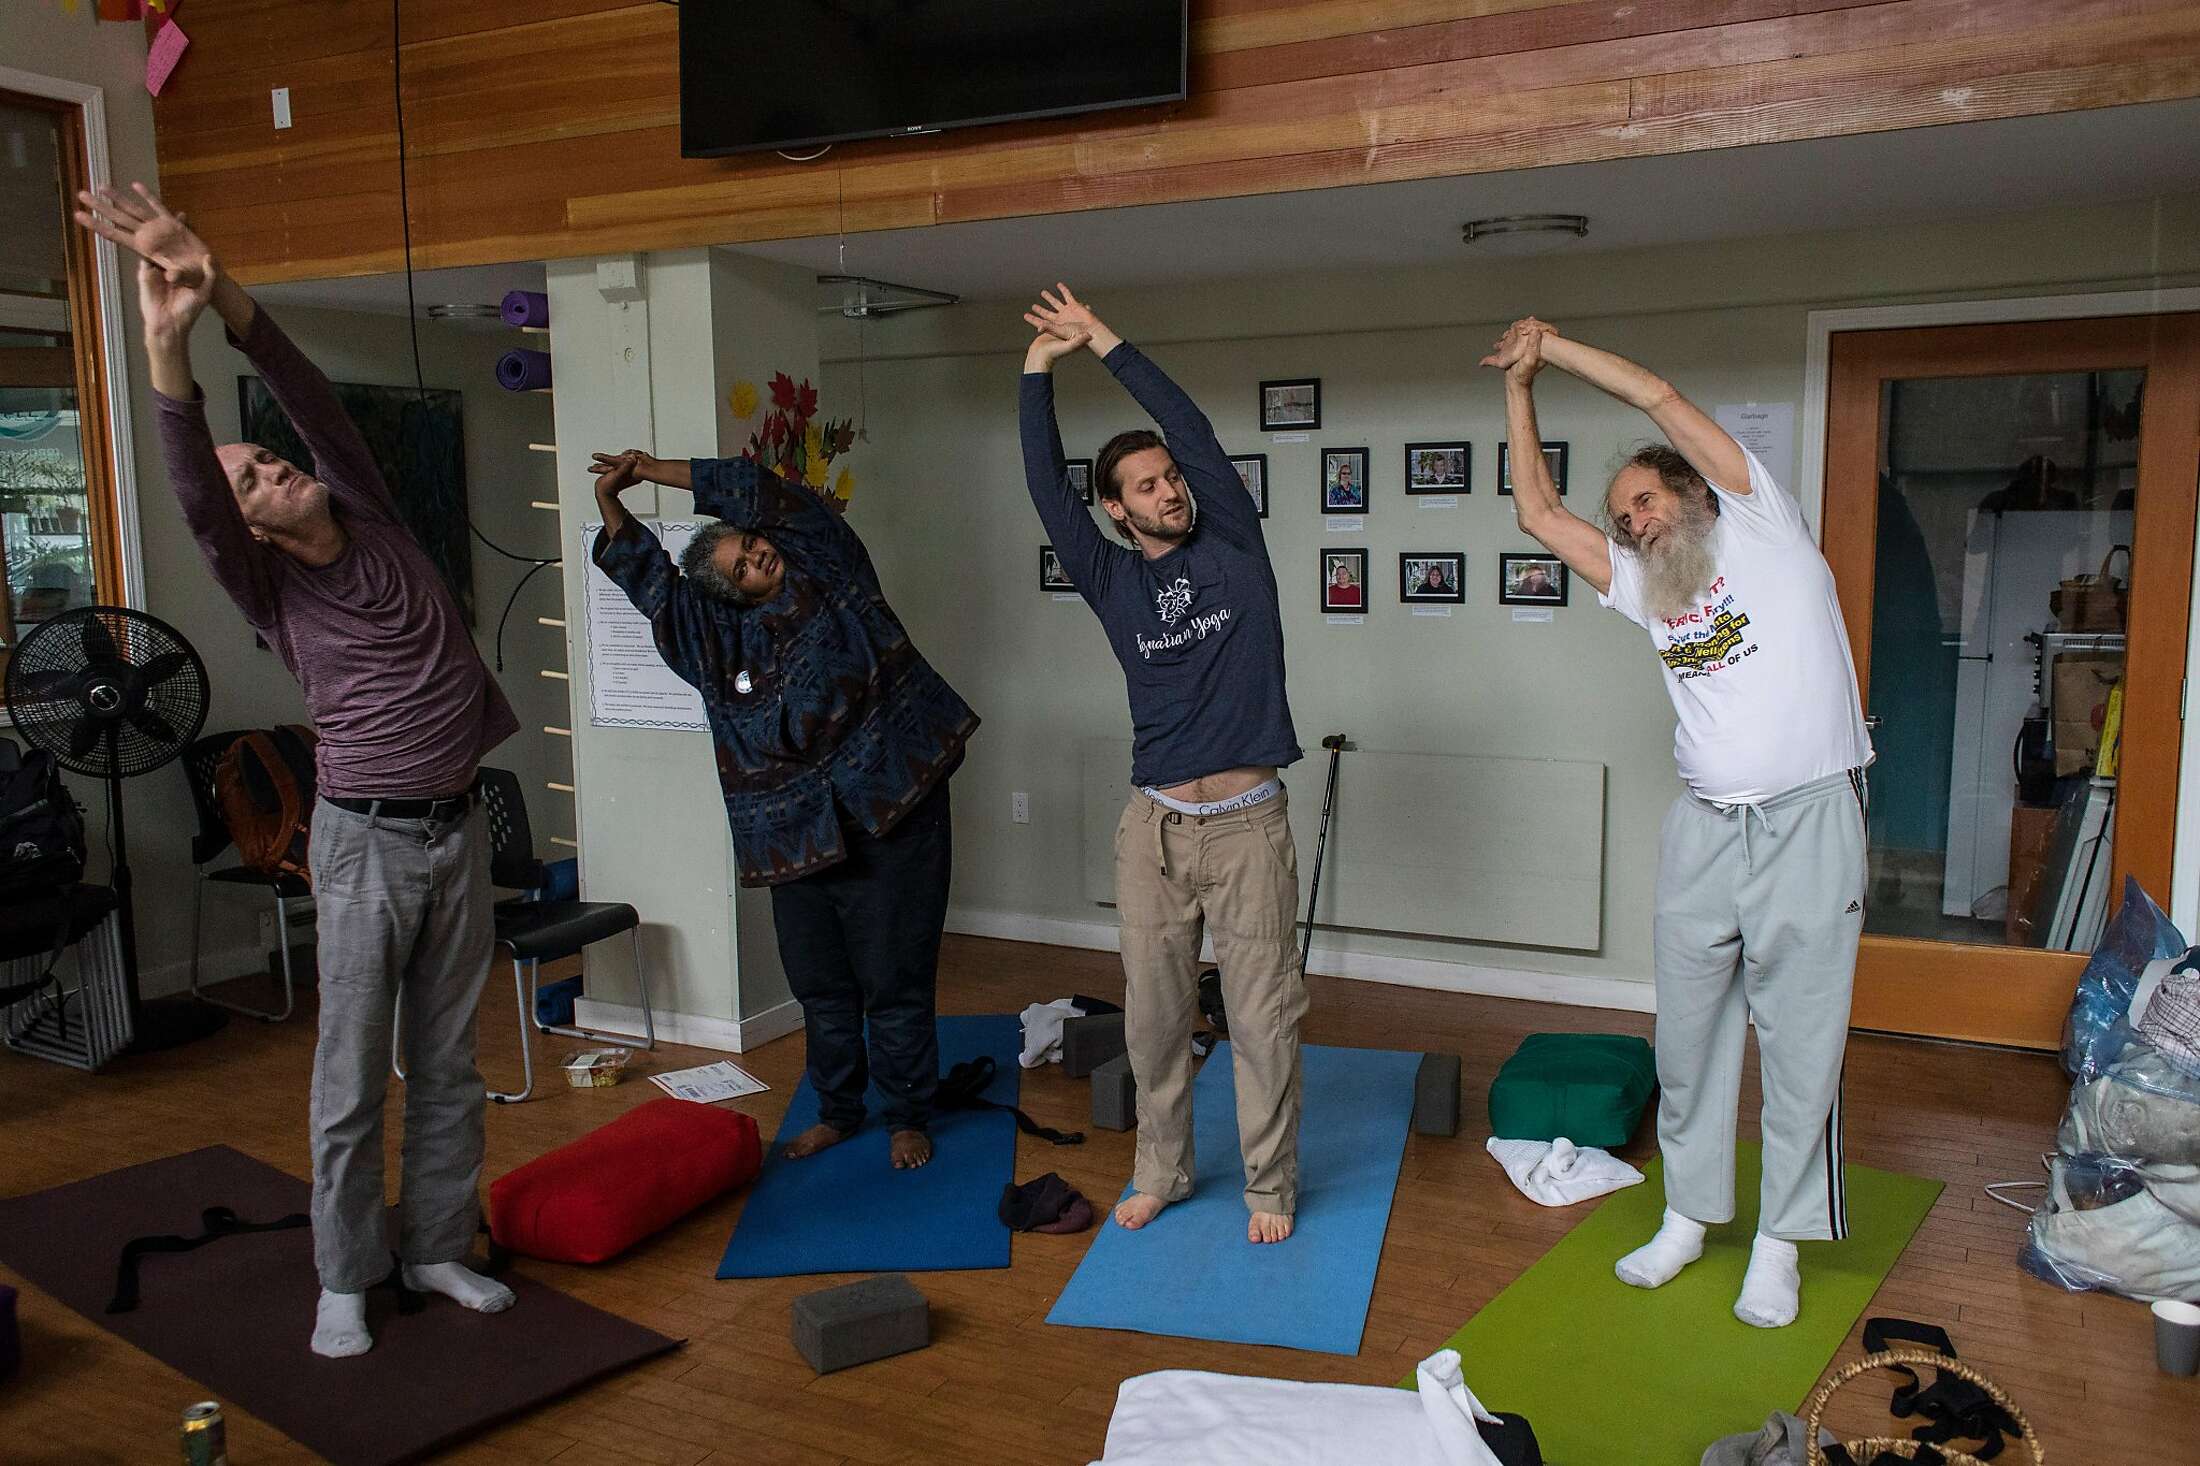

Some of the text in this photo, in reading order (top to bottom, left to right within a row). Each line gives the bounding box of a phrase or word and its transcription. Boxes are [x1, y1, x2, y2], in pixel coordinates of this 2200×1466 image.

[1136, 608, 1231, 659] Ignatian Yoga
[1706, 661, 1725, 673] ALL
[1728, 654, 1741, 665] OF
[1743, 643, 1759, 657] US
[1241, 789, 1270, 807] Klein
